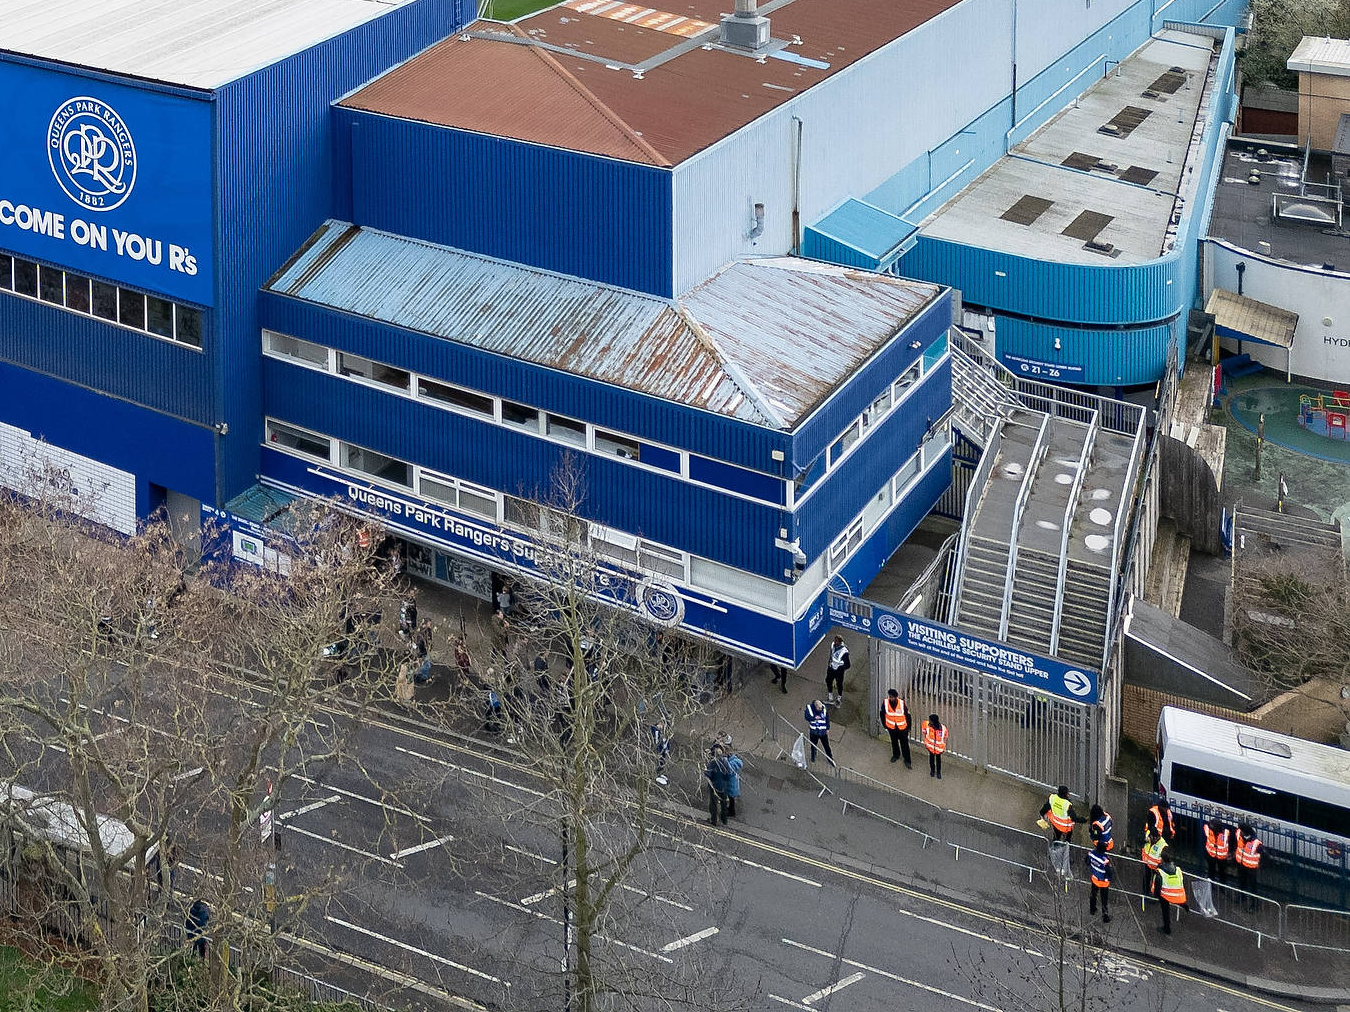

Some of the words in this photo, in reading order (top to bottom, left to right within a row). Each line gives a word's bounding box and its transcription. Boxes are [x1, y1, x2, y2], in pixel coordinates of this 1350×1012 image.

[51, 105, 75, 149] QUEENS
[76, 101, 102, 115] PARK
[103, 110, 133, 167] RANGERS
[79, 192, 105, 207] 1882
[70, 219, 108, 251] ON
[111, 228, 162, 265] YOU
[1031, 366, 1041, 374] 21
[1049, 369, 1060, 377] 26
[348, 485, 402, 515] Queens
[405, 503, 441, 529] Park
[444, 516, 510, 553] Rangers
[907, 621, 957, 644] VISITING
[959, 637, 1035, 668] SUPPORTERS
[908, 631, 921, 640] THE
[922, 634, 961, 652] ACHILLEUS
[962, 647, 997, 663] SECURITY
[998, 658, 1023, 671] STAND
[1024, 667, 1050, 680] UPPER
